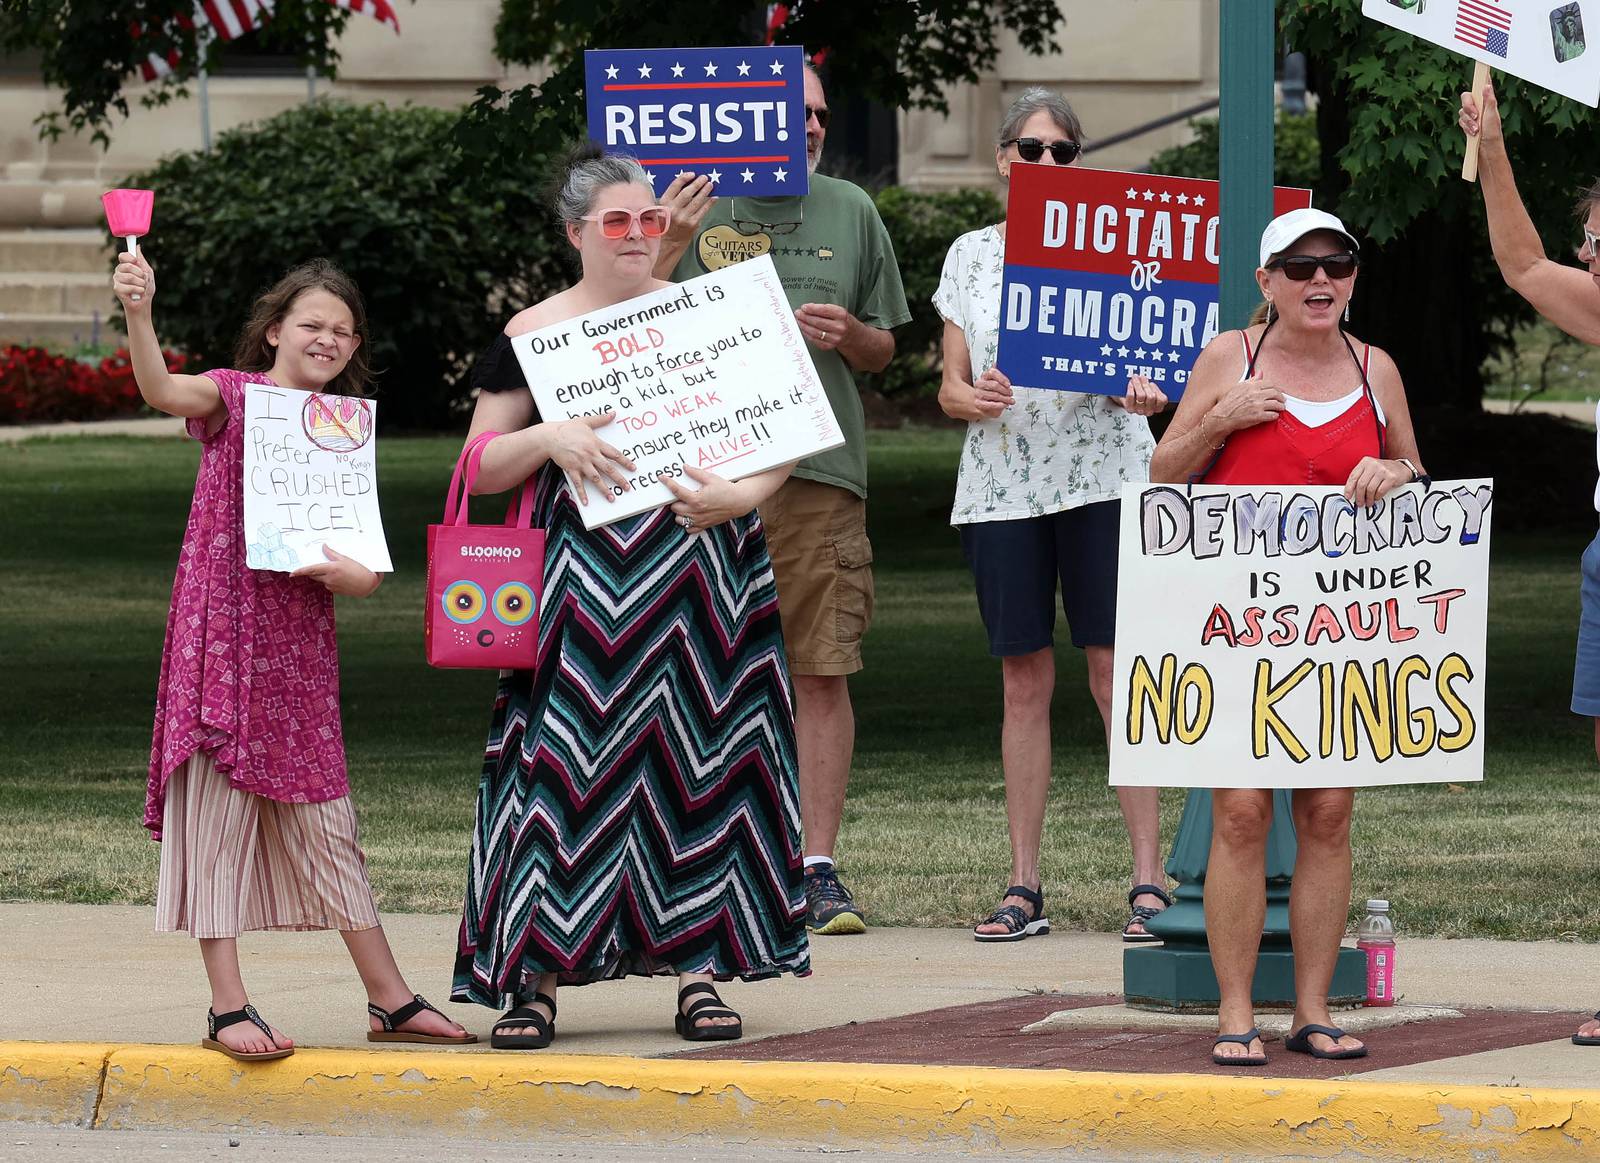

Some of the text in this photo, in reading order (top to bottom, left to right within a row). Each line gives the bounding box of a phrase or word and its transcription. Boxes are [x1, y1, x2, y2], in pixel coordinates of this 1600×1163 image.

[605, 101, 789, 145] RESIST!
[1043, 200, 1219, 264] DICTATO
[721, 251, 755, 262] VETS
[1130, 260, 1163, 291] OR
[817, 277, 838, 288] music
[531, 285, 725, 354] Our Government is
[1006, 283, 1219, 349] DEMOCRA
[556, 326, 762, 403] enough to force you to
[592, 328, 664, 365] BOLD
[620, 396, 633, 409] a
[636, 378, 674, 401] kid,
[682, 366, 717, 386] but
[1042, 356, 1116, 376] THAT'S
[1125, 365, 1166, 381] THE
[254, 389, 288, 420] I
[617, 391, 722, 434] TOO WEAK
[622, 385, 803, 462] ensure they make it
[250, 426, 321, 465] Prefer
[335, 454, 371, 471] NO Kings
[251, 466, 371, 497] CRUSHED
[609, 485, 623, 496] o
[276, 503, 364, 533] ICE!
[1141, 485, 1493, 559] DEMOCRACY
[460, 545, 521, 559] SLOOMOO
[1250, 560, 1432, 598] IS UNDER
[1201, 588, 1466, 647] ASSAULT
[1126, 653, 1476, 763] NO KINGS
